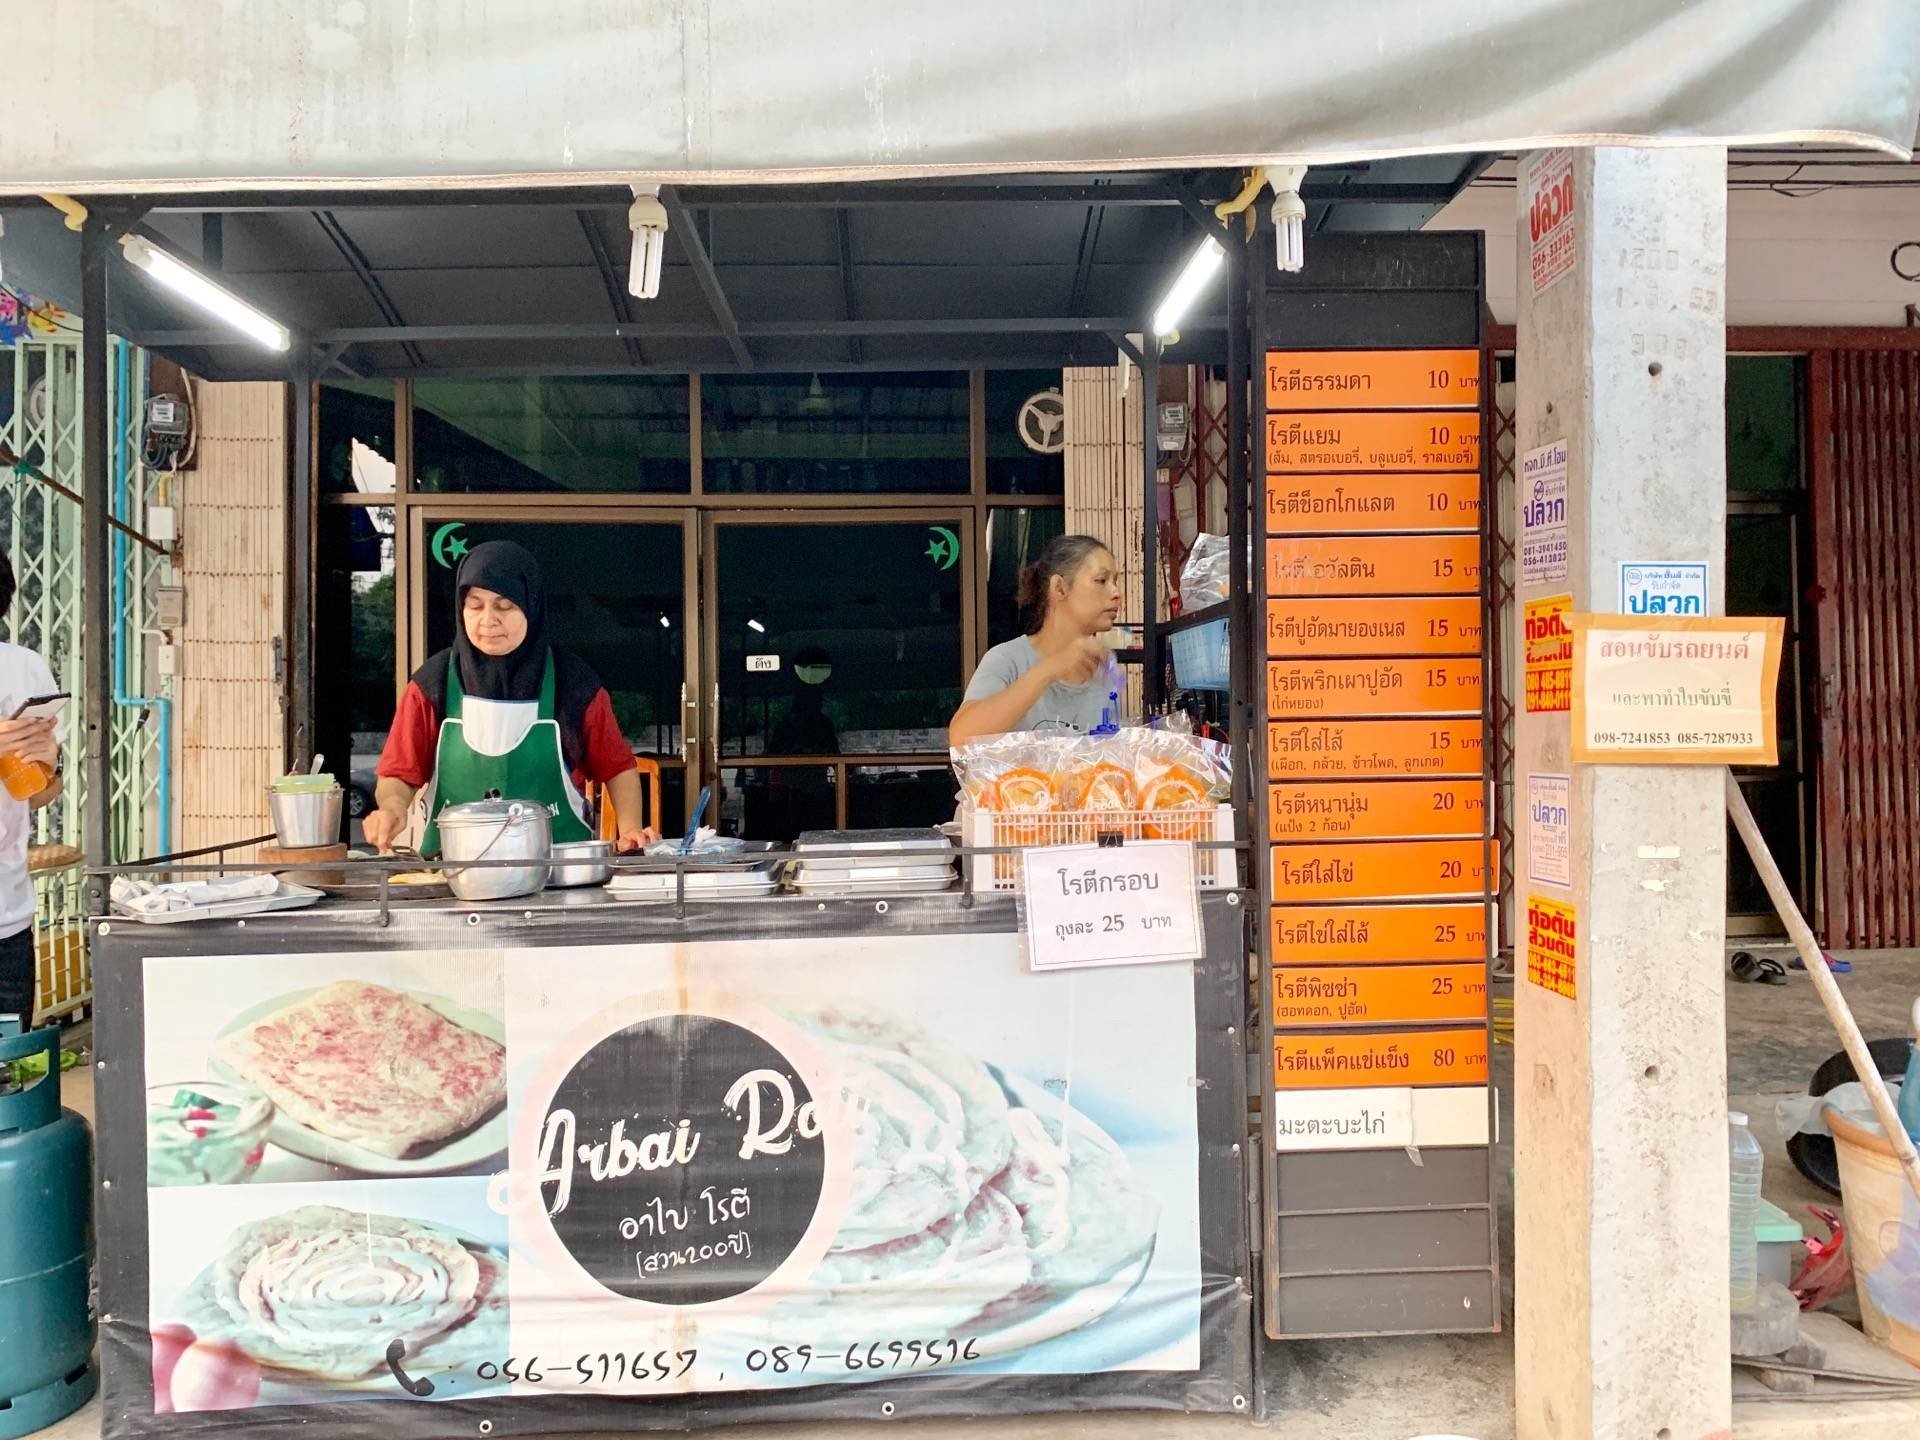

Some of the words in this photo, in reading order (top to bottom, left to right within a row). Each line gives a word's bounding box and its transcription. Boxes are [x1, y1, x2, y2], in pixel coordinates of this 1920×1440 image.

[1530, 174, 1575, 242] ปลวก
[1269, 366, 1371, 391] โรตีธรรมดา
[1428, 370, 1449, 388] 10
[1269, 420, 1341, 445] โรตีแยม
[1430, 426, 1450, 444] 10
[1268, 488, 1395, 514] โรตีช็อกโกแลต
[1427, 492, 1449, 511] 10
[1459, 499, 1480, 511] บาท
[1523, 498, 1564, 528] ปลวก
[1433, 559, 1453, 577] 15
[1464, 567, 1480, 577] บา
[1629, 589, 1699, 614] ปลวก
[1268, 613, 1405, 645] โรตีปูอัดมายองเนส
[1428, 619, 1449, 637] 15
[1459, 626, 1481, 637] บาท
[1601, 633, 1751, 660] สอนขับรถยนต์
[1270, 666, 1402, 695] โรตีพริกเผาปูอัด
[1426, 669, 1447, 687] 15
[1457, 674, 1480, 686] บาท
[1612, 681, 1732, 706] และพาทำใบขับขี่
[1270, 727, 1343, 752] โรตีใส่ไส้
[1430, 731, 1450, 749] 15
[1461, 737, 1482, 749] บาท
[1594, 732, 1671, 744] 098-7241853
[1677, 732, 1753, 744] 085-7287933
[1273, 790, 1368, 820] โรตีหนานุ่ม
[1433, 792, 1454, 810] 20
[1532, 799, 1567, 826] ปลวก
[1309, 820, 1316, 832] 2
[1057, 868, 1159, 896] โรตีกรอบ
[1282, 859, 1353, 884] โรตีใส่ไข่
[1440, 861, 1461, 878] 20
[1055, 922, 1094, 941] ถุงละ
[1102, 914, 1125, 932] 25
[1141, 914, 1172, 930] บาท
[1276, 919, 1369, 944] โรตีไข่ใส่ไส้
[1434, 926, 1456, 942] 25
[1528, 904, 1575, 939] ท่อตัน
[1275, 974, 1357, 998] โรตีพิซซ่า
[1432, 978, 1453, 995] 25
[1463, 983, 1486, 994] บาท
[1275, 1045, 1409, 1070] โรตีแพ็คแช่แข็ง
[1434, 1048, 1455, 1066] 80
[1464, 1054, 1487, 1066] บาท
[1279, 1109, 1385, 1135] มะตะบะไก่
[488, 1109, 701, 1216] Arbai
[700, 1186, 751, 1225] โรตี
[746, 1337, 981, 1374] 089-6699516
